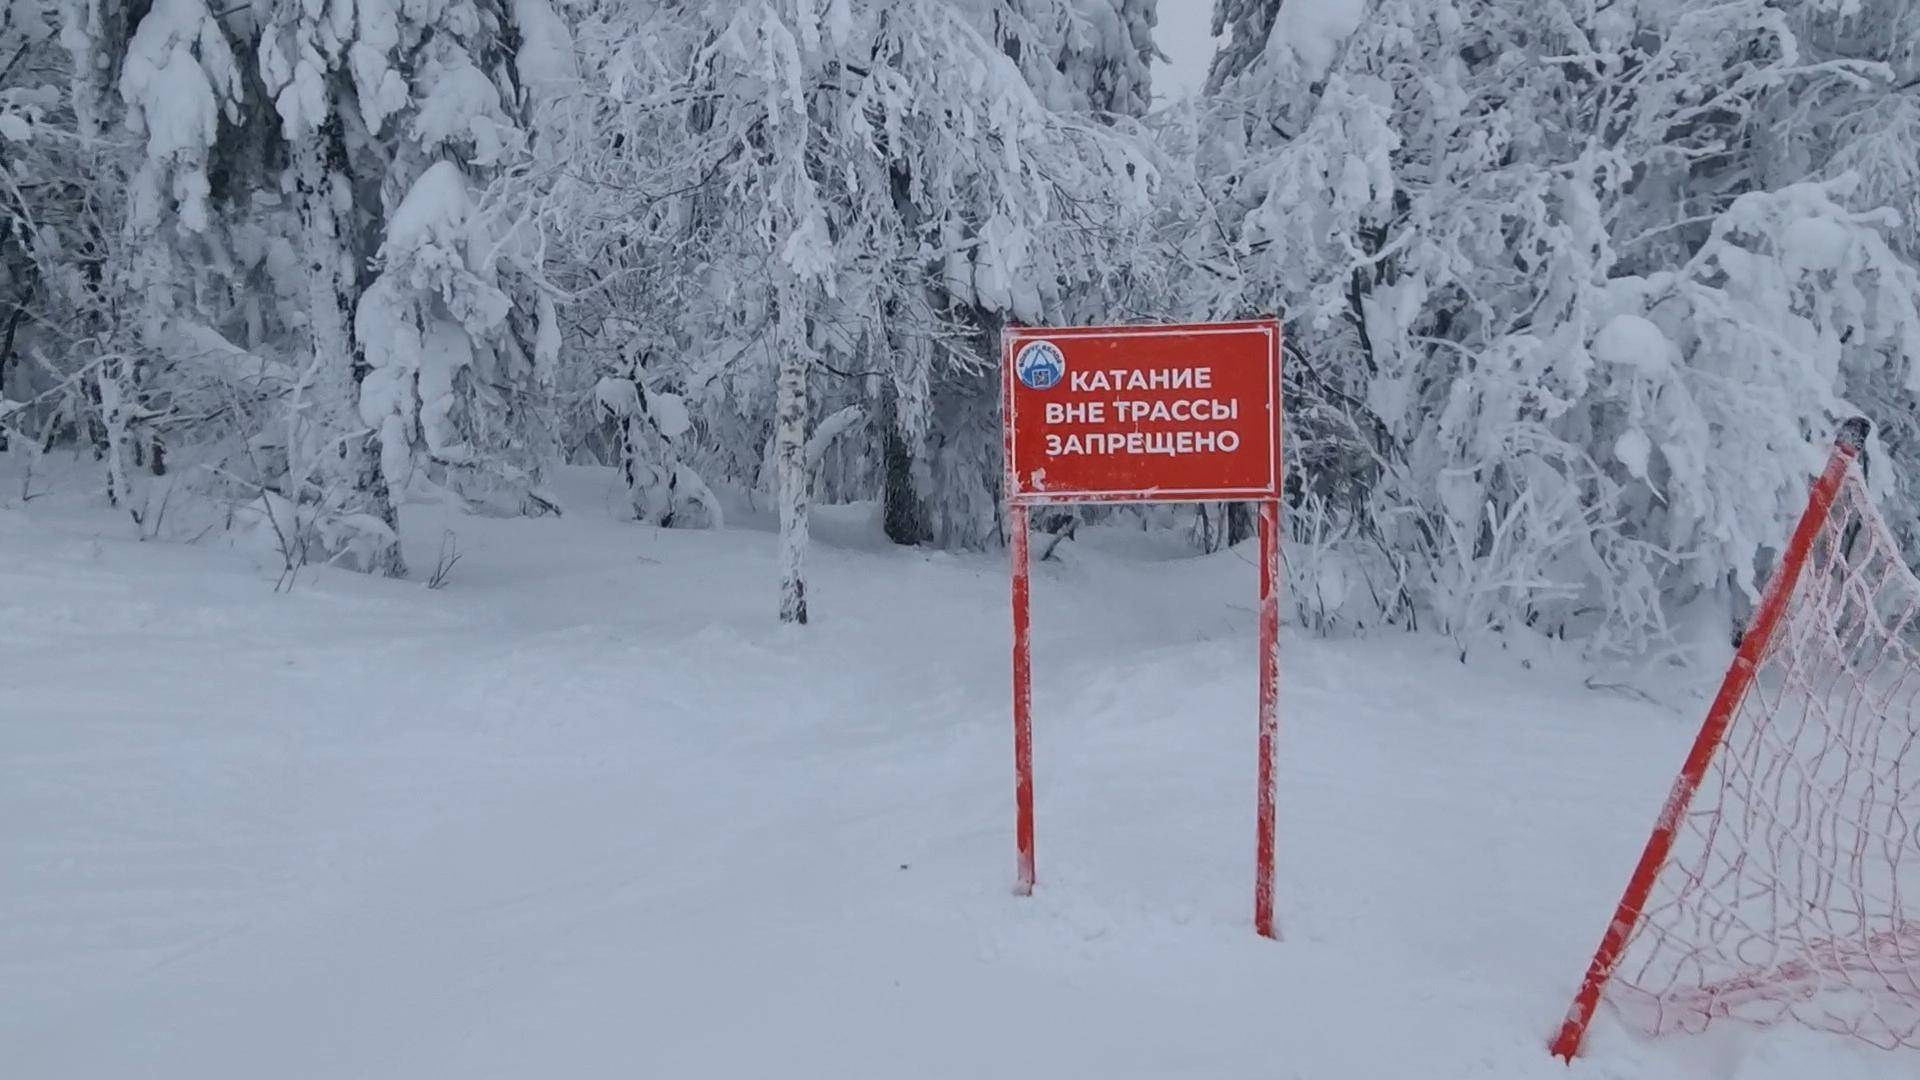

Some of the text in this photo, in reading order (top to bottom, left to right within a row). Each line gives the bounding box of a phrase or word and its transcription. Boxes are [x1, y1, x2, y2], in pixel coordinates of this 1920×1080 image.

[1070, 367, 1212, 392] КАТАНИЕ
[1045, 398, 1238, 424] ВНЕ ТРАССЫ
[1045, 430, 1240, 457] ЗАПРЕЩЕНО
